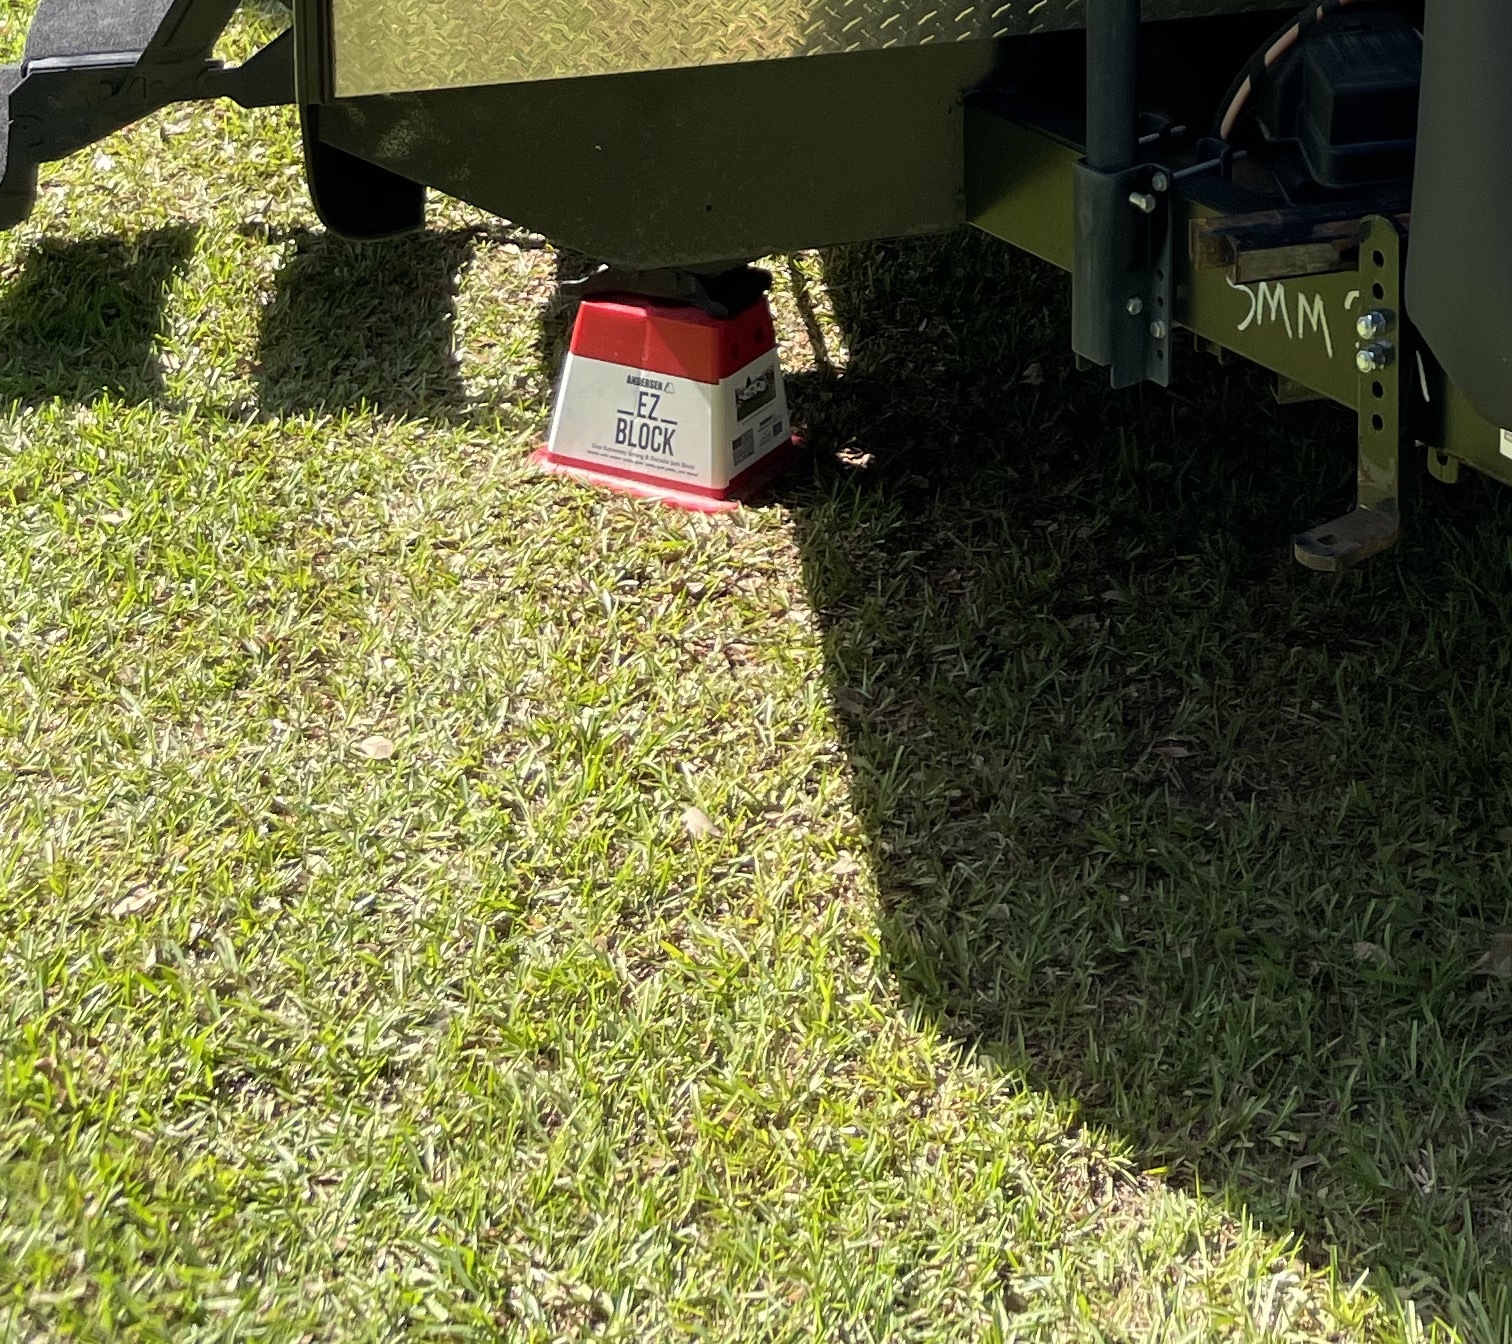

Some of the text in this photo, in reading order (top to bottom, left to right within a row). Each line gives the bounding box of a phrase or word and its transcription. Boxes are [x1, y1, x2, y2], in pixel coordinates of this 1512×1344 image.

[626, 375, 663, 391] ANDERSEN
[637, 391, 661, 421] EZ
[615, 417, 676, 456] BLOCK
